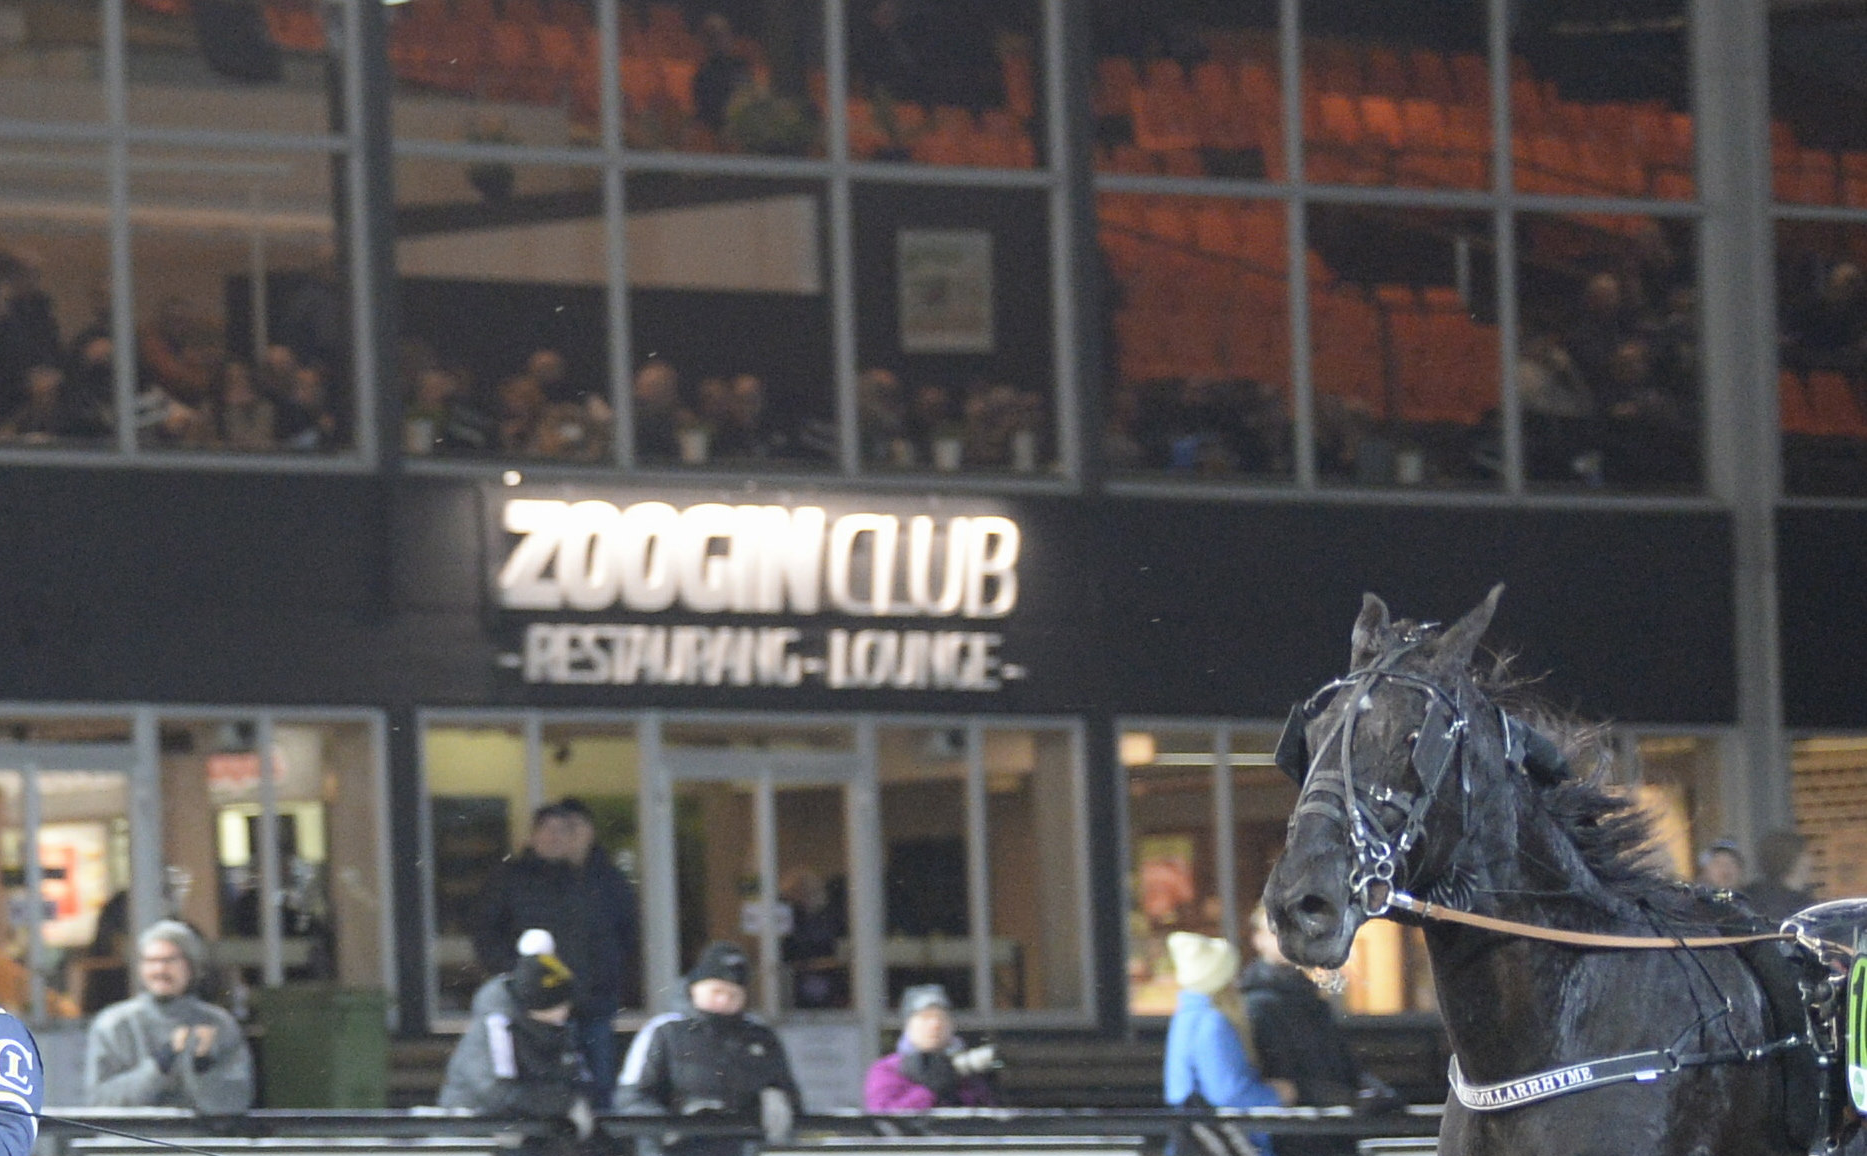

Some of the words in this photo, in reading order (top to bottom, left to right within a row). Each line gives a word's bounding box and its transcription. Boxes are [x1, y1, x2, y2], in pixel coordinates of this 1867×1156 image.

[500, 499, 826, 615] ZOOGIN
[833, 513, 1021, 619] CLUB
[1853, 964, 1867, 1067] 1
